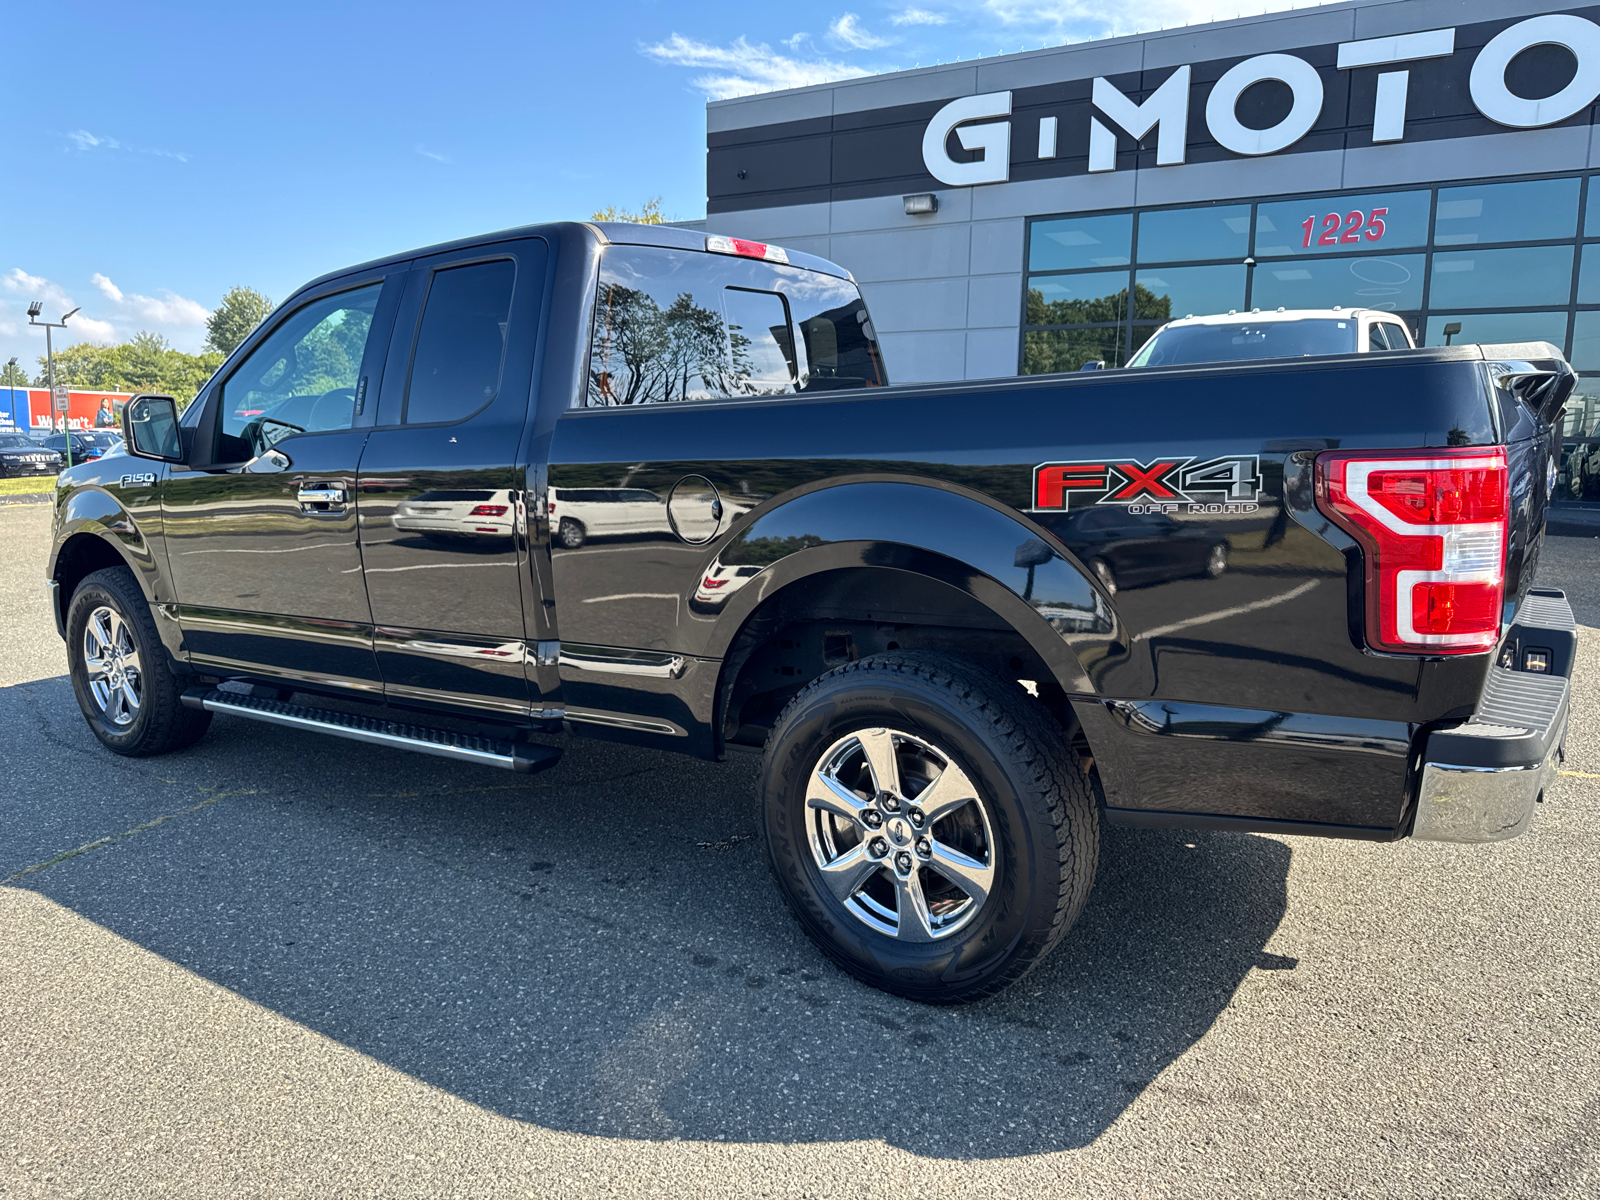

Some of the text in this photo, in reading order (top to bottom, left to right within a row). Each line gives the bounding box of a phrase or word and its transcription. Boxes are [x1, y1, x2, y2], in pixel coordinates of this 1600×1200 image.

[1302, 207, 1389, 248] 1225
[1032, 454, 1263, 512] FX4
[1128, 503, 1259, 515] OFF ROAD
[775, 741, 836, 932] WRANGLER
